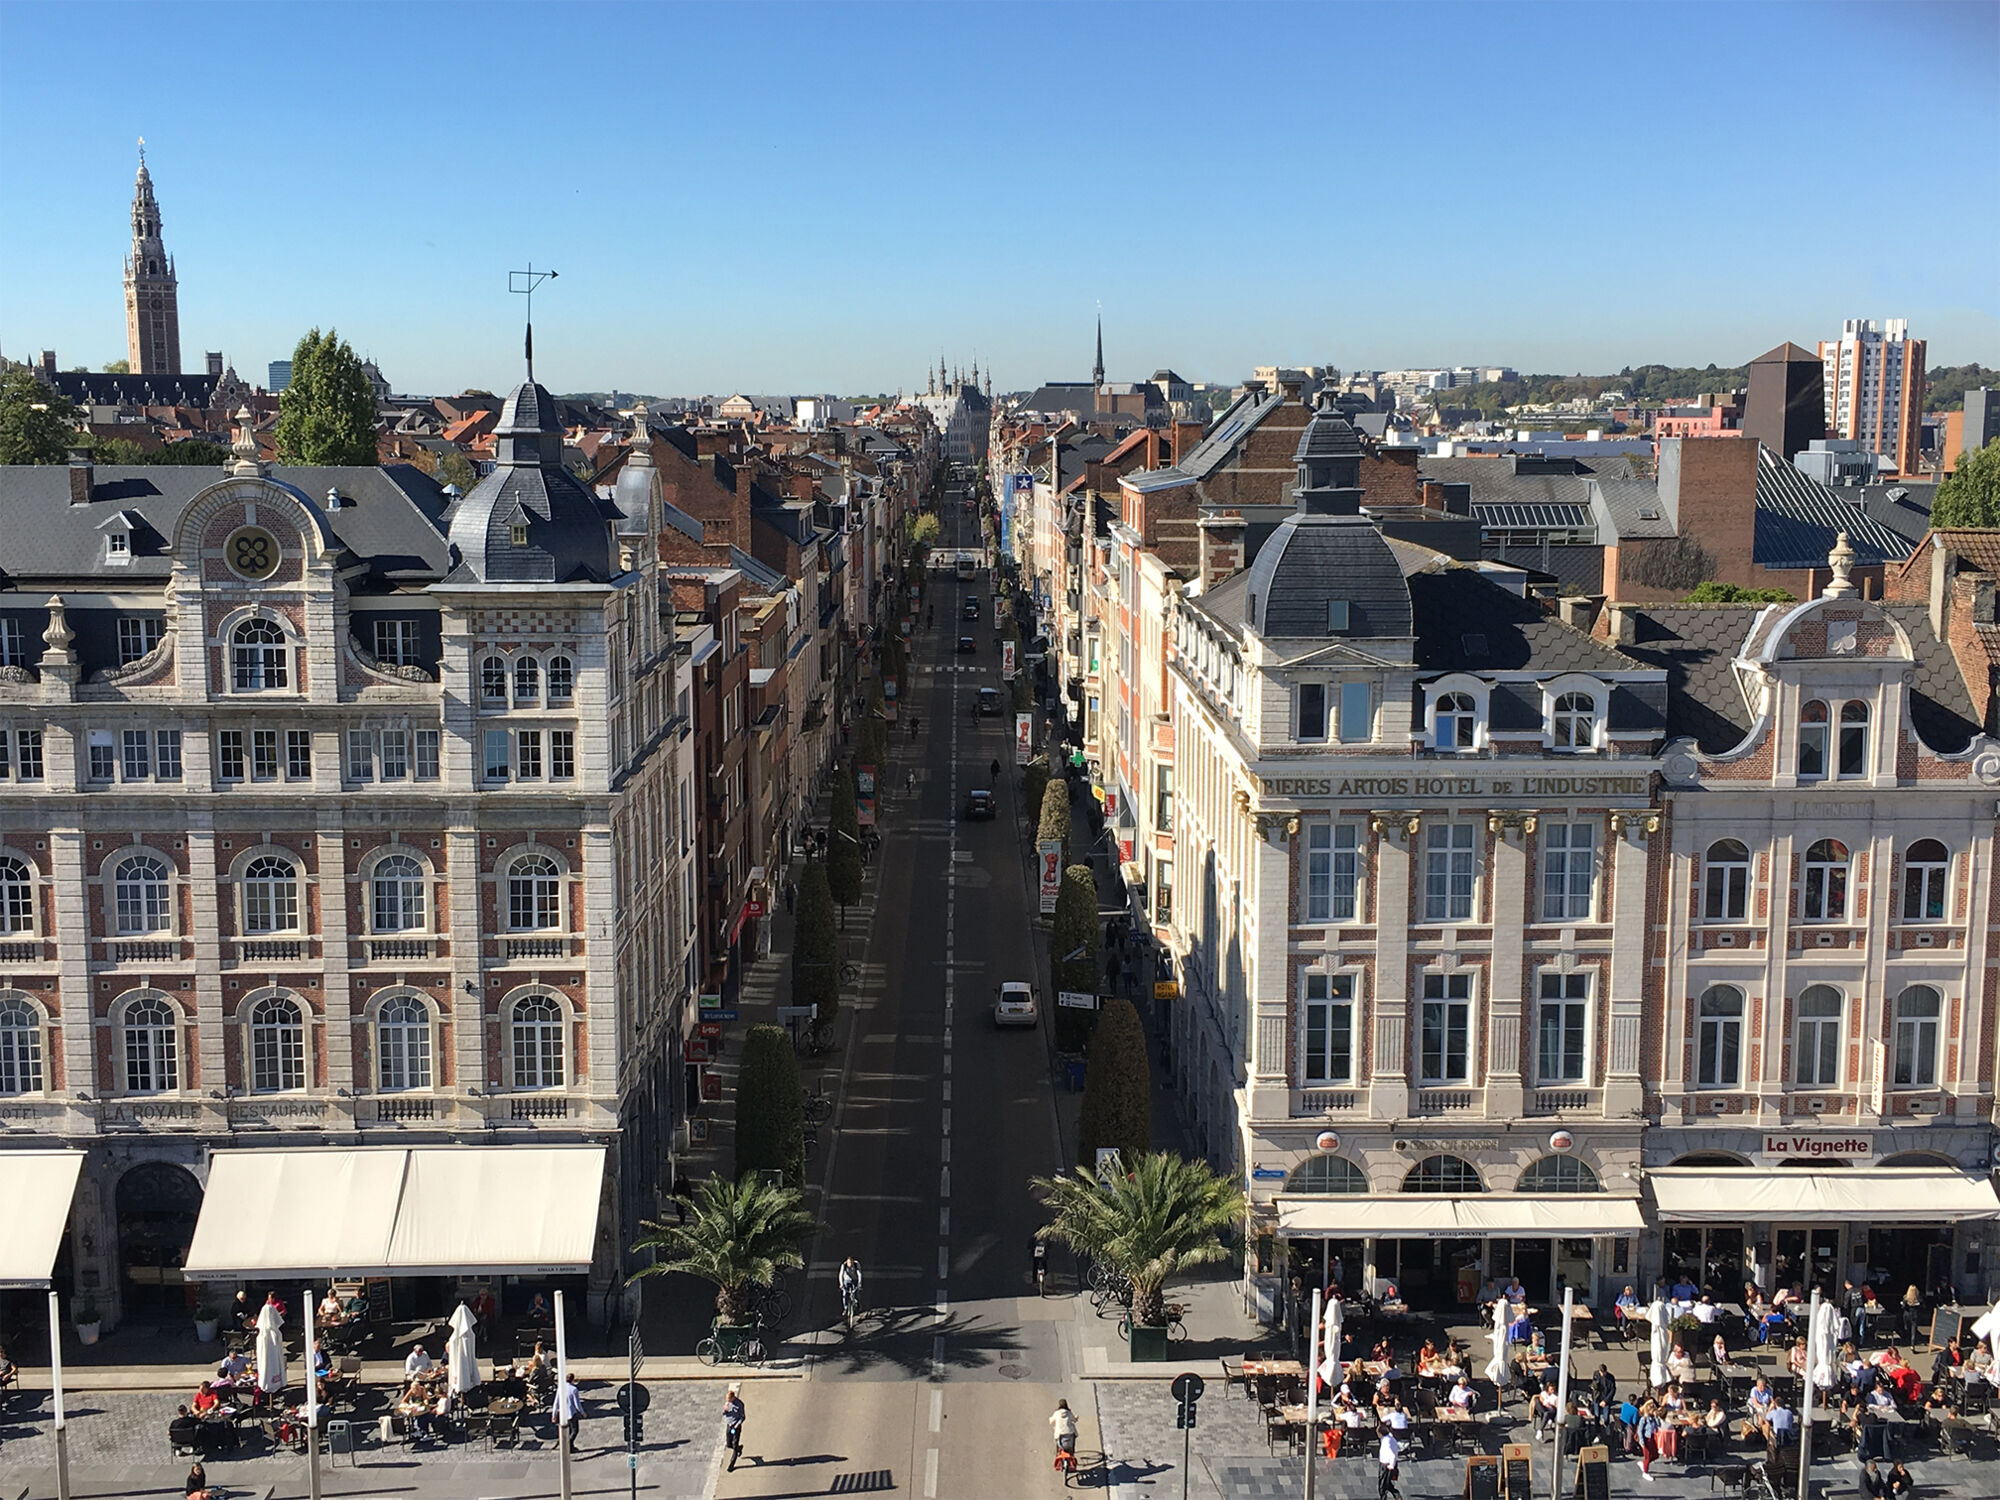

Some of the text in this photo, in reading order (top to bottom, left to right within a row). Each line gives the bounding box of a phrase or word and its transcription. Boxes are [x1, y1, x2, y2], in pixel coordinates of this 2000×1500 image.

[1263, 778, 1331, 795] BIERES
[1338, 778, 1408, 795] ARTOIS
[1414, 777, 1482, 795] HOTEL
[1523, 777, 1645, 794] L'INDUSTRIE
[1, 1104, 328, 1121] OTEL LA ROYALE RESTAURANT
[1767, 1138, 1868, 1156] La Vignette
